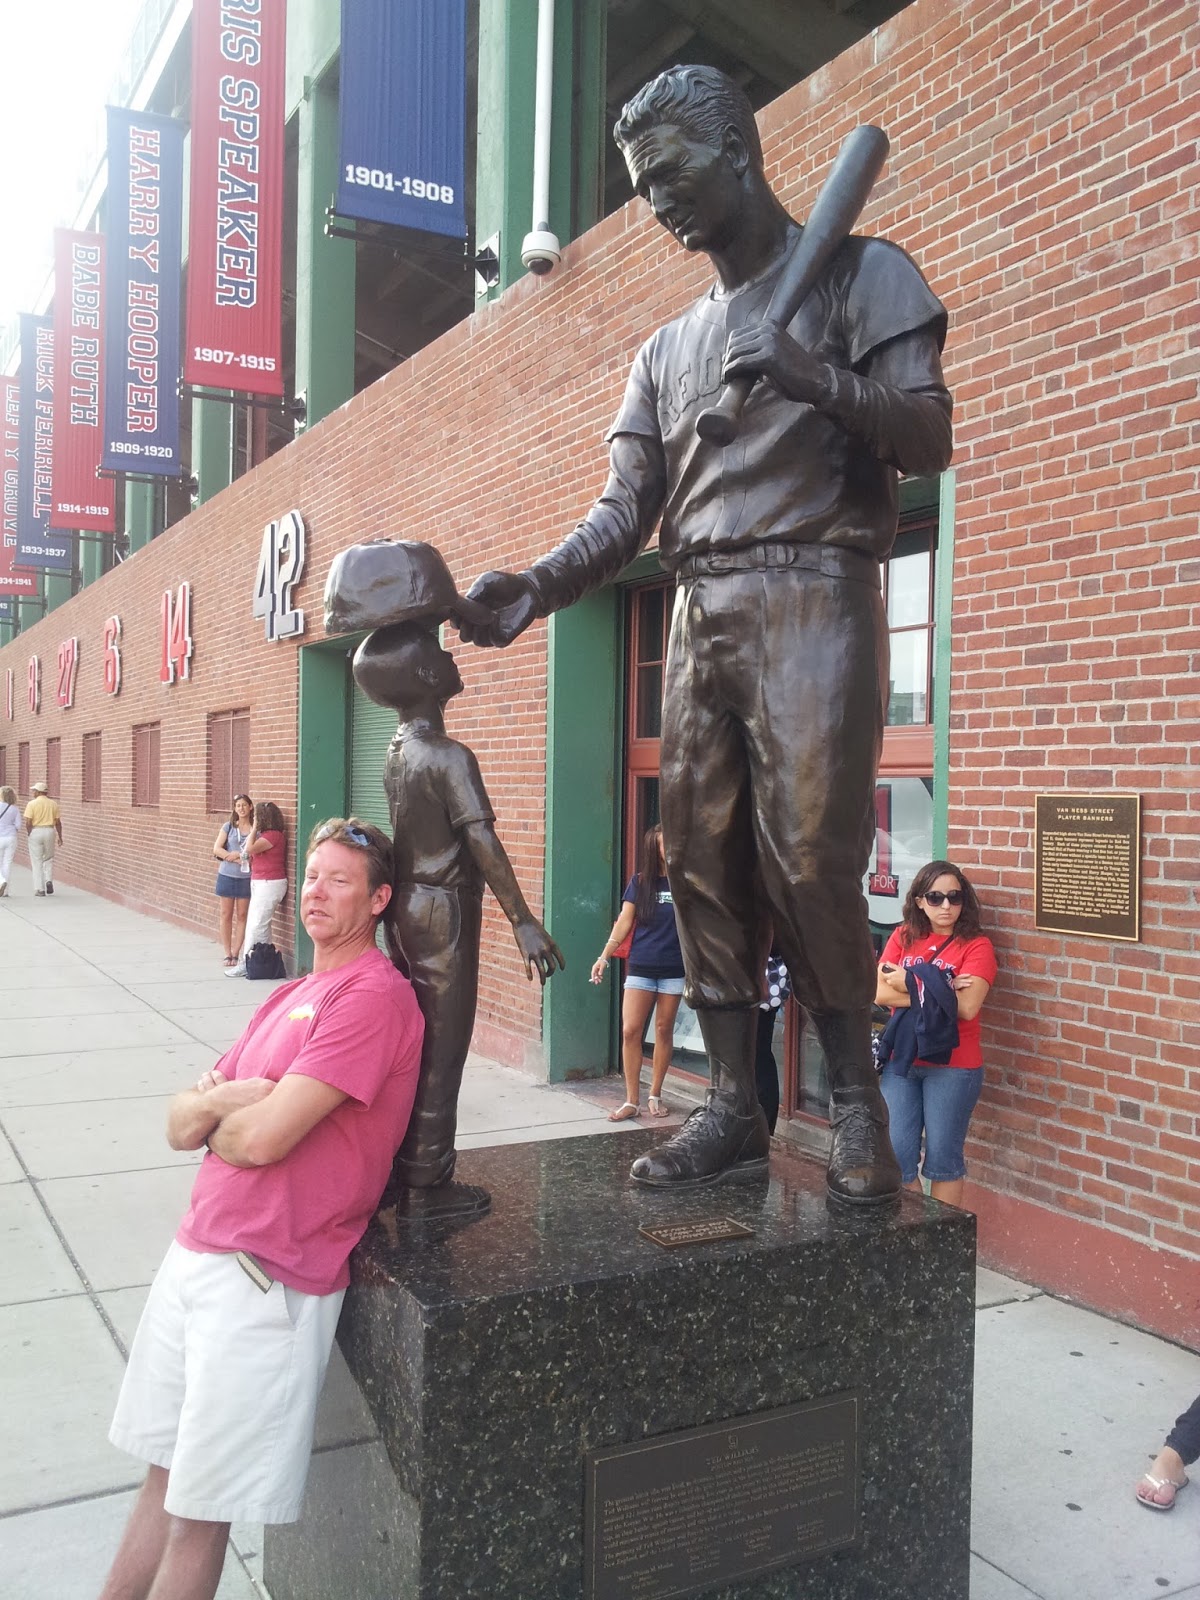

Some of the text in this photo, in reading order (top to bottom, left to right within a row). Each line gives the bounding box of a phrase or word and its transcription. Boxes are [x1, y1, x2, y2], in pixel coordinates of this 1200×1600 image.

[216, 75, 260, 309] SPEAKER
[346, 164, 454, 204] 1901-1908
[127, 126, 160, 434] HARRY HOOPER
[71, 243, 100, 427] BABE RUTH
[194, 346, 276, 372] 1907-1915
[33, 327, 54, 518] RICK FERRELL
[110, 442, 172, 459] 1909-1920
[57, 502, 109, 516] 1914-1919
[21, 545, 66, 557] 1933-1937
[252, 508, 304, 642] 42
[104, 615, 122, 696] 6
[159, 581, 192, 684] 14
[28, 655, 38, 713] 8
[58, 636, 77, 708] 27
[874, 875, 895, 889] FOR
